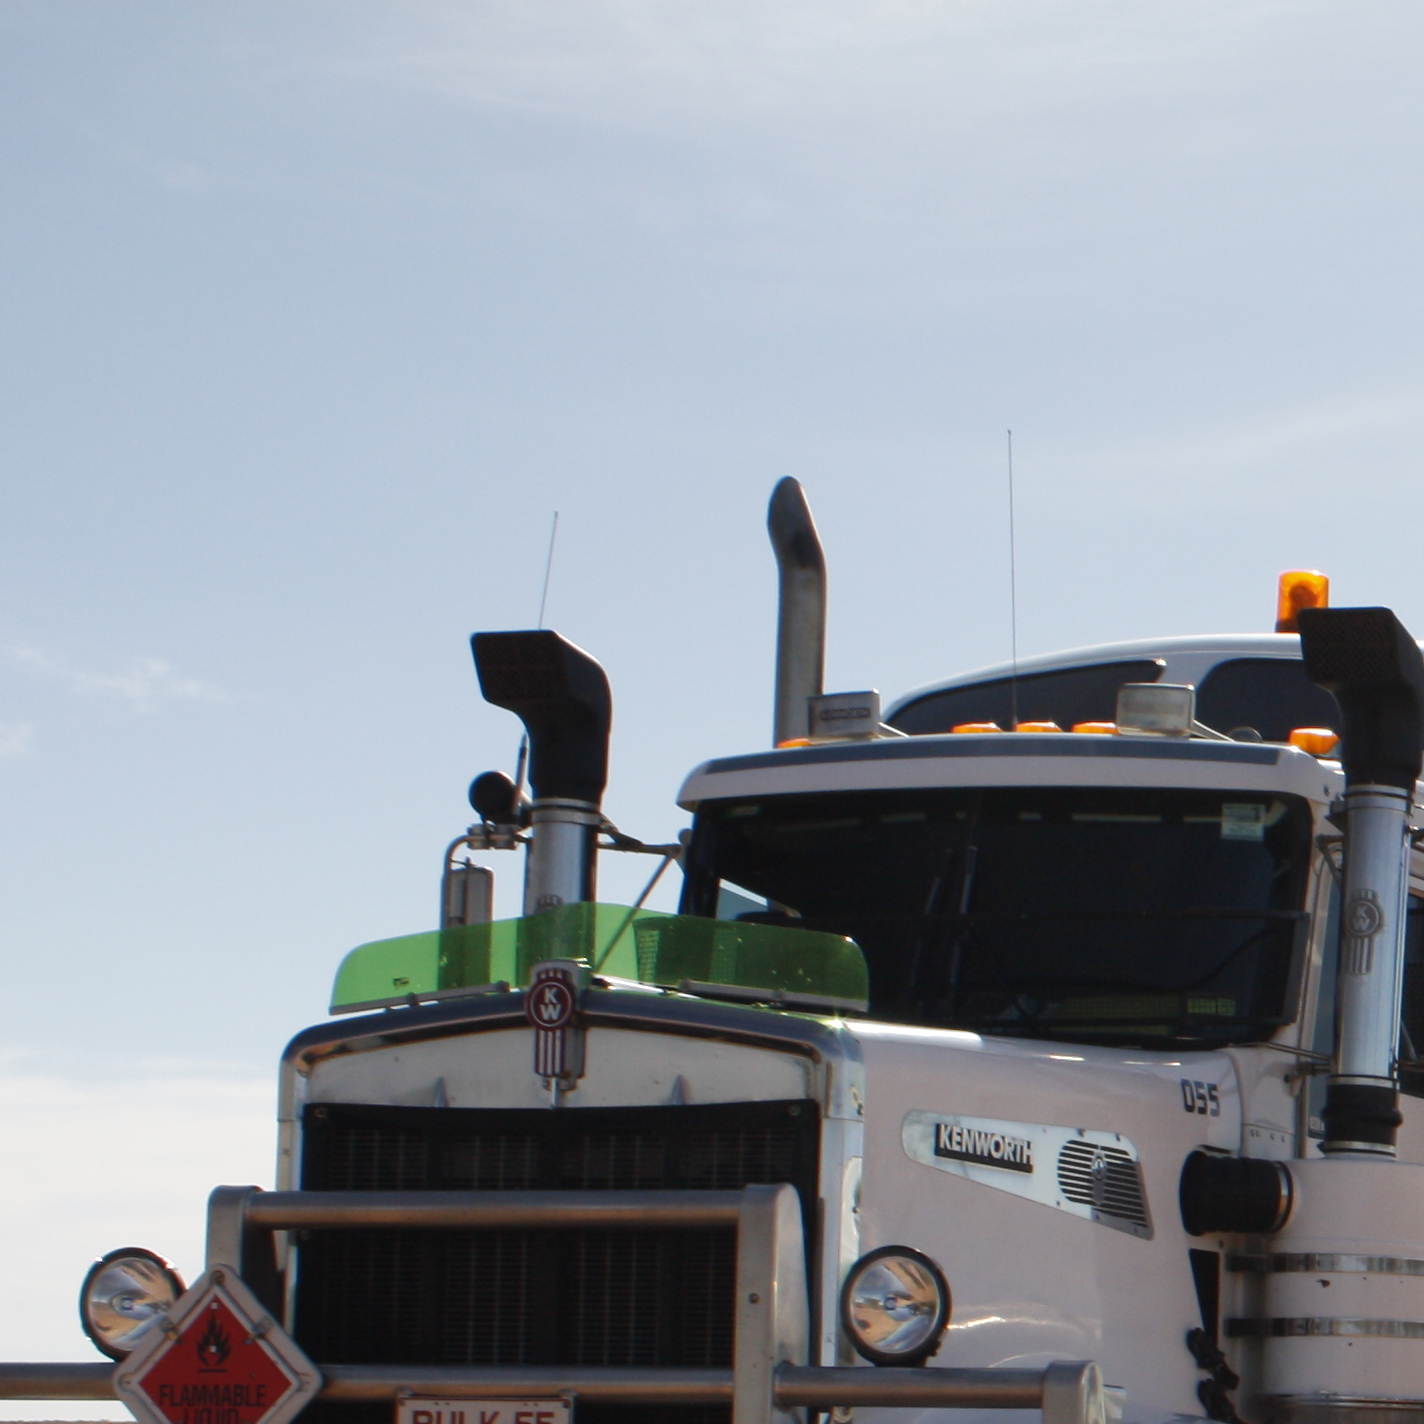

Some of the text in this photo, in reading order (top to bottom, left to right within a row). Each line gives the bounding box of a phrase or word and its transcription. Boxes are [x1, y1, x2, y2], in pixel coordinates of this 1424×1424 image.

[1181, 1078, 1220, 1117] 055
[938, 1123, 1033, 1165] KENWORTH
[158, 1383, 267, 1408] FLAMMABLE
